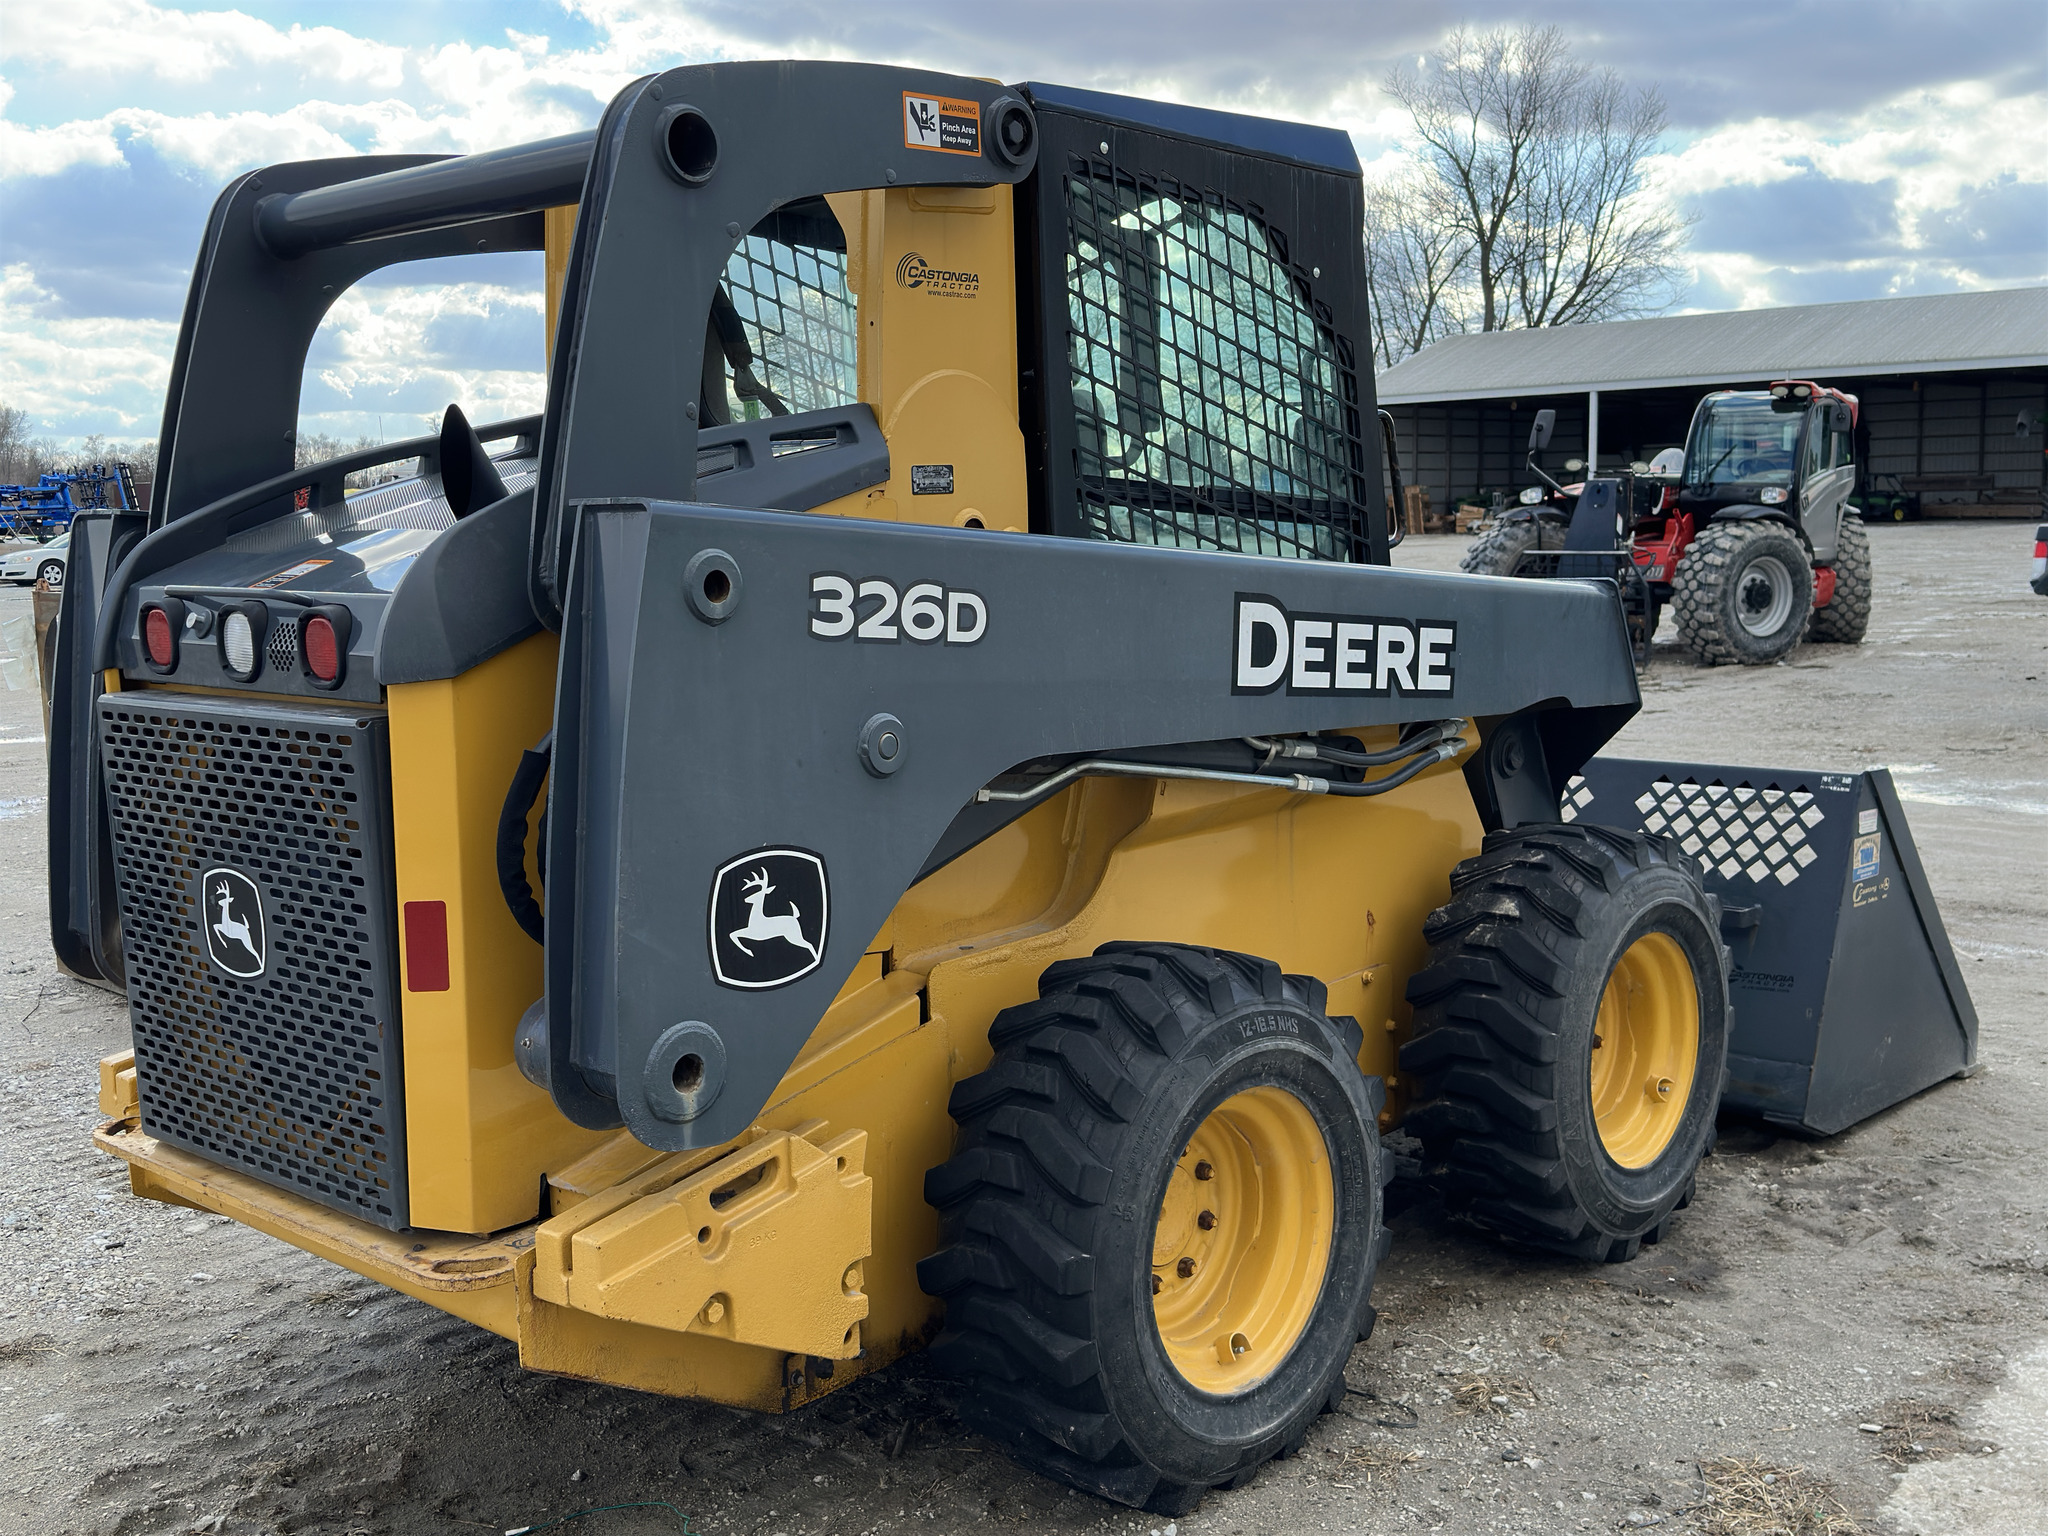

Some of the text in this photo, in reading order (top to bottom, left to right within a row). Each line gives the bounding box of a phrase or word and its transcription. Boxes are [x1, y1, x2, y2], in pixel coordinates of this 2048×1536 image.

[948, 103, 976, 115] WARNING
[942, 122, 976, 135] Pinch Area
[942, 134, 972, 146] Keep Away
[908, 266, 979, 284] CASTONGIA
[926, 281, 979, 291] TRACTOR
[927, 290, 976, 299] www.castrac.com
[811, 575, 988, 644] 326D
[1236, 600, 1454, 692] DEERE
[1276, 1015, 1299, 1034] NHS
[764, 1230, 776, 1241] KG
